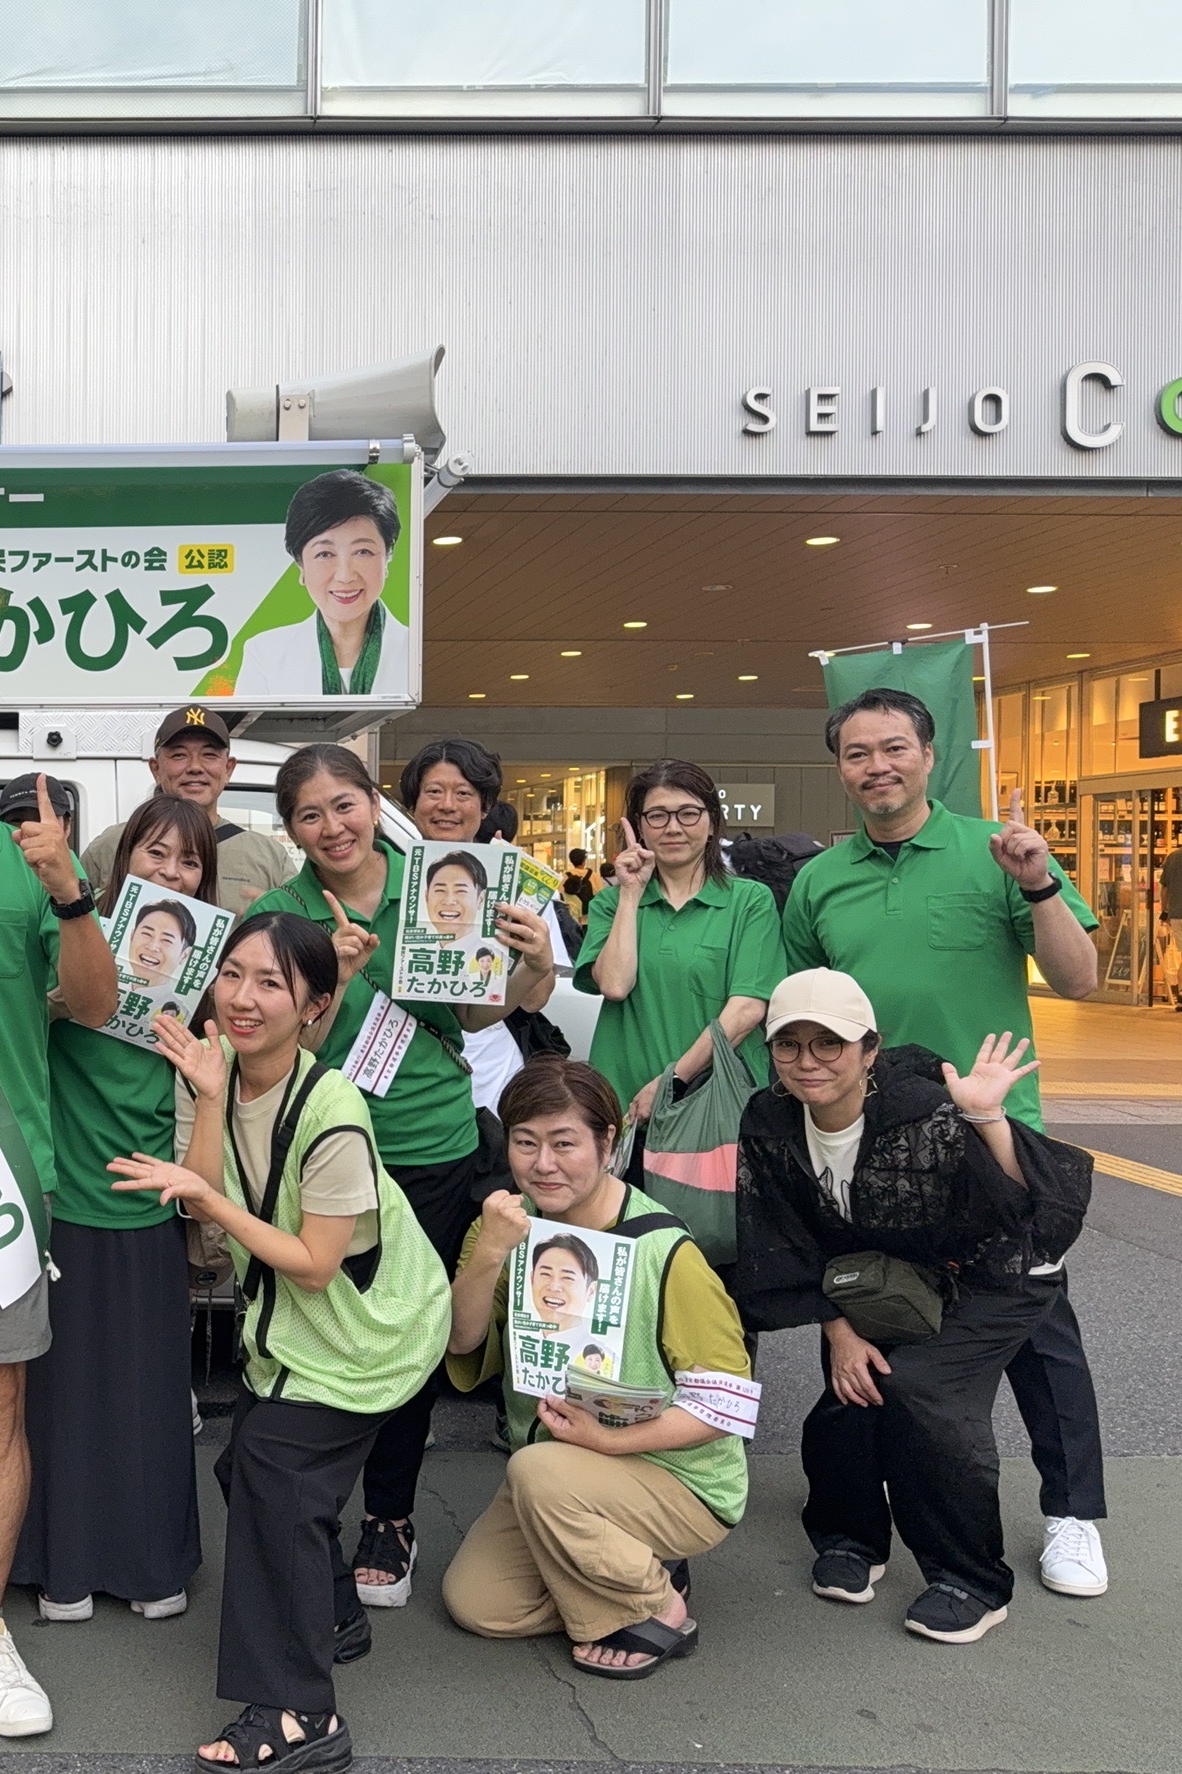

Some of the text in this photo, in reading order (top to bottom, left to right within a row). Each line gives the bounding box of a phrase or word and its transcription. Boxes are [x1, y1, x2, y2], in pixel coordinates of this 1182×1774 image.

[742, 386, 1010, 436] SEIJO
[184, 548, 230, 572] 公認
[186, 708, 205, 725] NY
[498, 855, 515, 918] 私が皆さん
[110, 885, 140, 951] 元TBSアナウンサ
[408, 948, 466, 977] 高野
[406, 976, 486, 998] たかひろ
[105, 1015, 160, 1045] かひろ
[516, 1242, 526, 1306] BSアナウンサー
[609, 1247, 628, 1325] 私が皆さんの声を
[518, 1335, 571, 1372] 高野
[522, 1367, 566, 1395] たかひ
